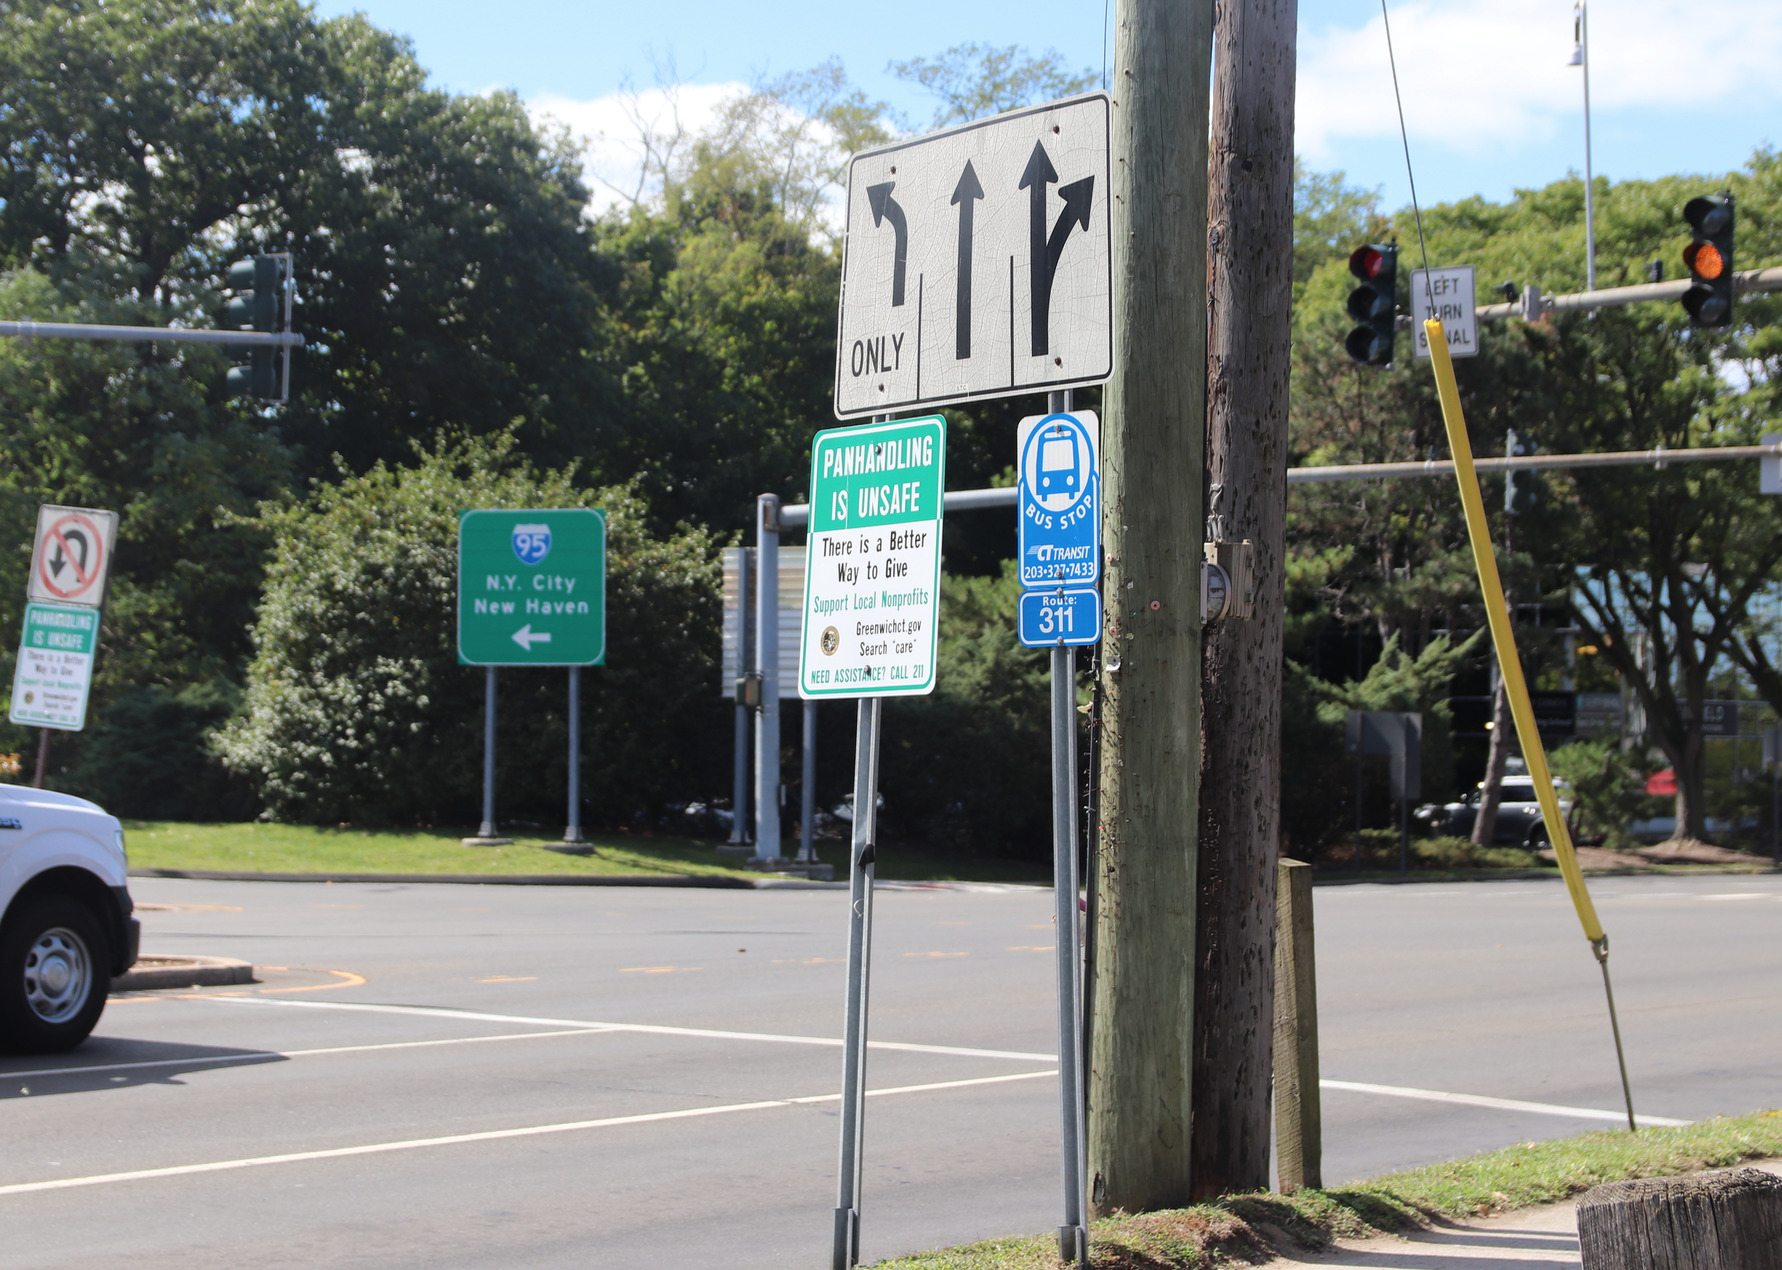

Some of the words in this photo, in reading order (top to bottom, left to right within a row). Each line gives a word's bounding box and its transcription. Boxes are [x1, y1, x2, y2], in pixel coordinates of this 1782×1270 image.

[1425, 277, 1460, 296] LEFT
[1425, 303, 1462, 321] TURN
[1419, 328, 1471, 348] SNAL
[851, 332, 905, 378] ONLY
[823, 435, 933, 478] PANHANDLING
[831, 490, 848, 521] IS
[858, 481, 921, 518] UNSAFE
[1025, 503, 1053, 529] BUS
[1060, 494, 1092, 530] STOP
[515, 534, 547, 557] 95
[822, 537, 853, 557] There
[860, 534, 869, 554] is
[876, 537, 882, 552] a
[890, 529, 927, 551] Better
[1053, 545, 1091, 561] TRANSIT
[838, 562, 859, 585] Way
[867, 561, 878, 580] to
[885, 558, 908, 579] Give
[486, 574, 522, 591] N.Y.
[532, 574, 576, 595] City
[474, 598, 515, 614] New
[526, 598, 589, 614] Haven
[813, 594, 849, 616] Support
[853, 591, 877, 610] Local
[881, 587, 929, 611] Nonprofits
[1042, 595, 1077, 606] Route:
[856, 619, 922, 636] Greenwichct.gov
[1039, 606, 1073, 634] 311
[859, 641, 888, 656] Search
[811, 669, 830, 684] NEED
[890, 665, 908, 680] CALL
[912, 664, 924, 679] 211
